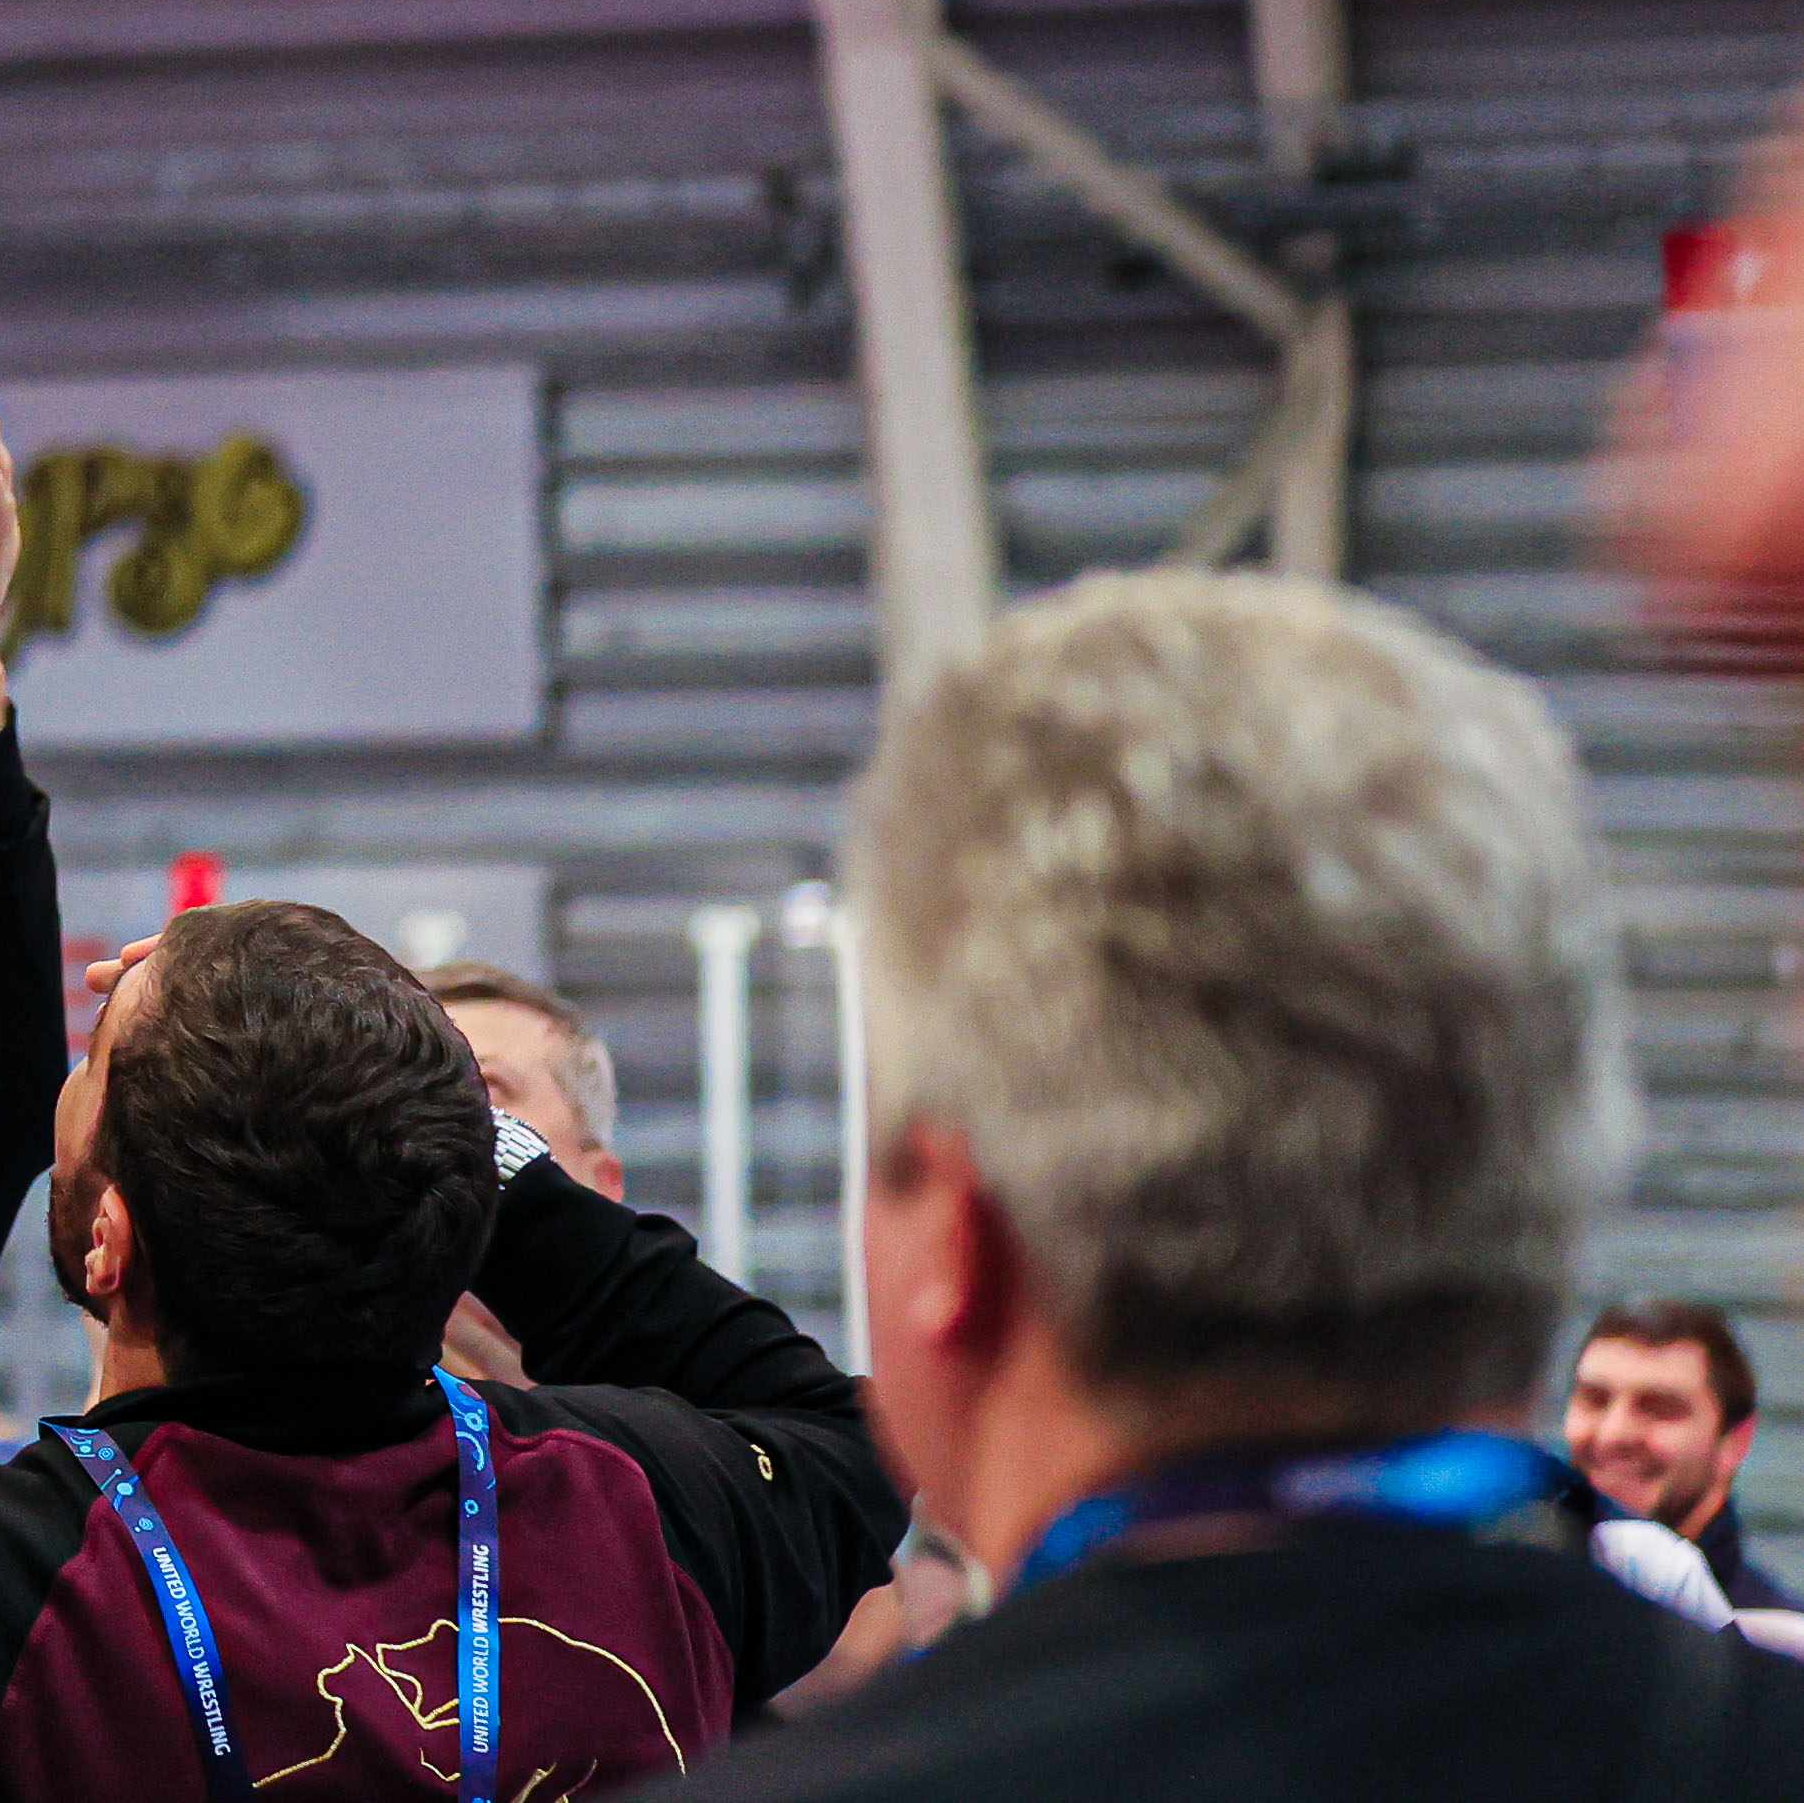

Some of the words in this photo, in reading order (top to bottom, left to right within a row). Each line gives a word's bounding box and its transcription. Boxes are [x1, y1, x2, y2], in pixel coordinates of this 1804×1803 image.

[471, 1544, 490, 1633] WRESTLING
[152, 1546, 187, 1599] UNITED
[175, 1599, 205, 1659] WORLD
[192, 1660, 232, 1756] WRESTLING
[472, 1638, 489, 1694] WORLD
[472, 1696, 489, 1754] UNITED
